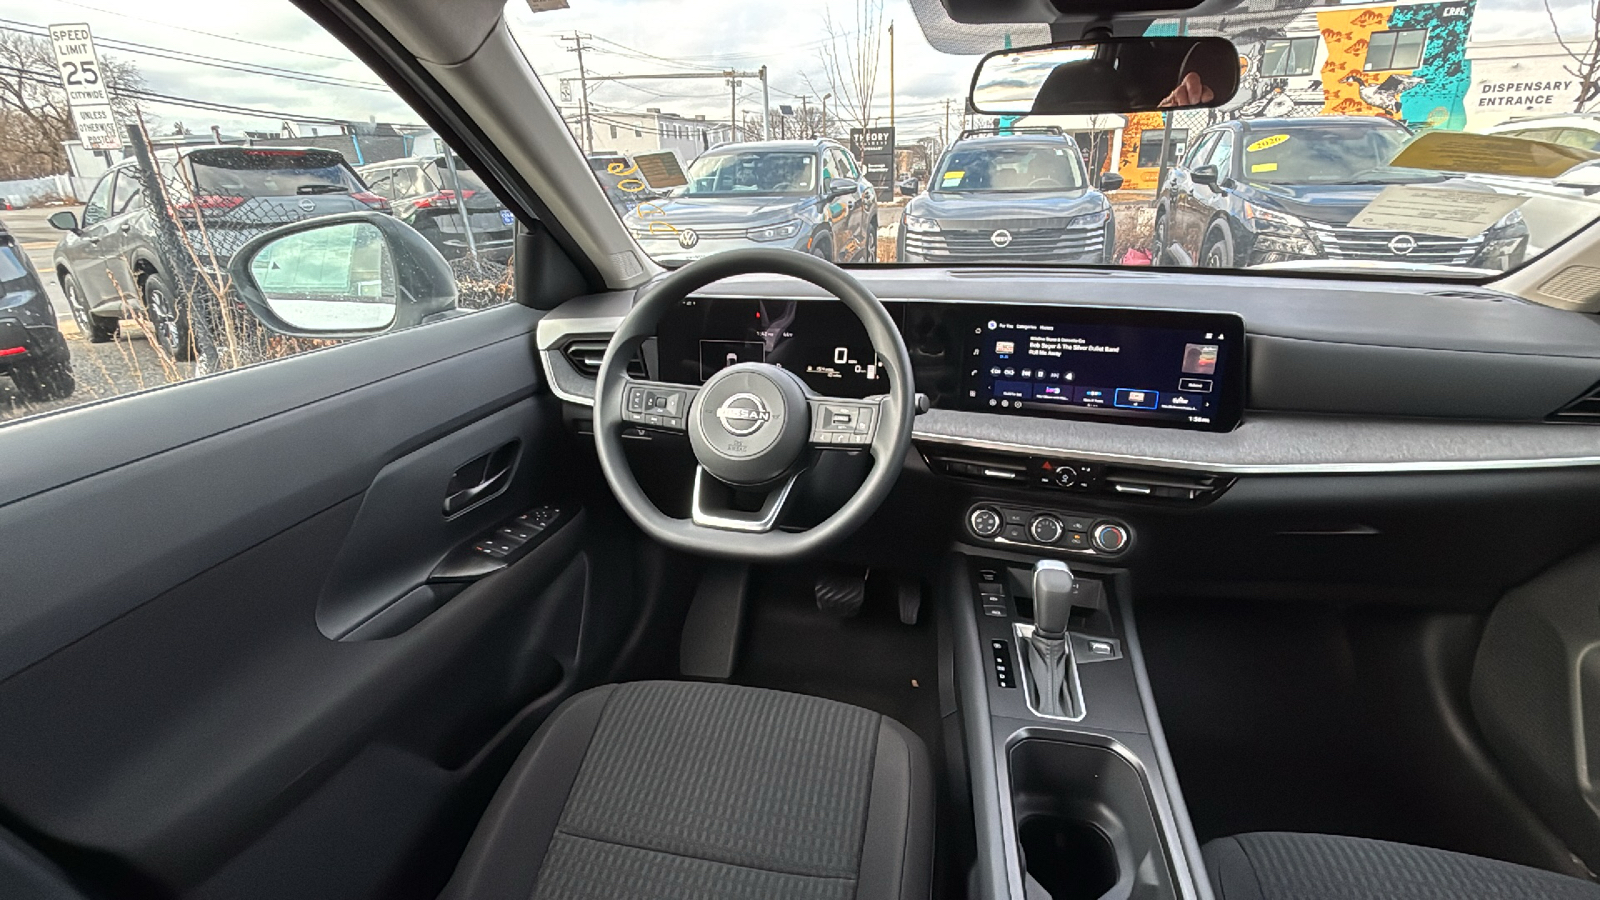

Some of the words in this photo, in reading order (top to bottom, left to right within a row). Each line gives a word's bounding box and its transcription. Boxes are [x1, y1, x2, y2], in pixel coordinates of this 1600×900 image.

[52, 29, 89, 41] SPEED
[58, 43, 88, 56] LIMIT
[61, 60, 99, 86] 25
[1481, 80, 1573, 94] DISPENSARY
[69, 89, 105, 100] CITYWIDE
[1478, 94, 1554, 107] ENTRANCE
[79, 110, 108, 120] UNLESS
[79, 122, 116, 133] OTHERWISE
